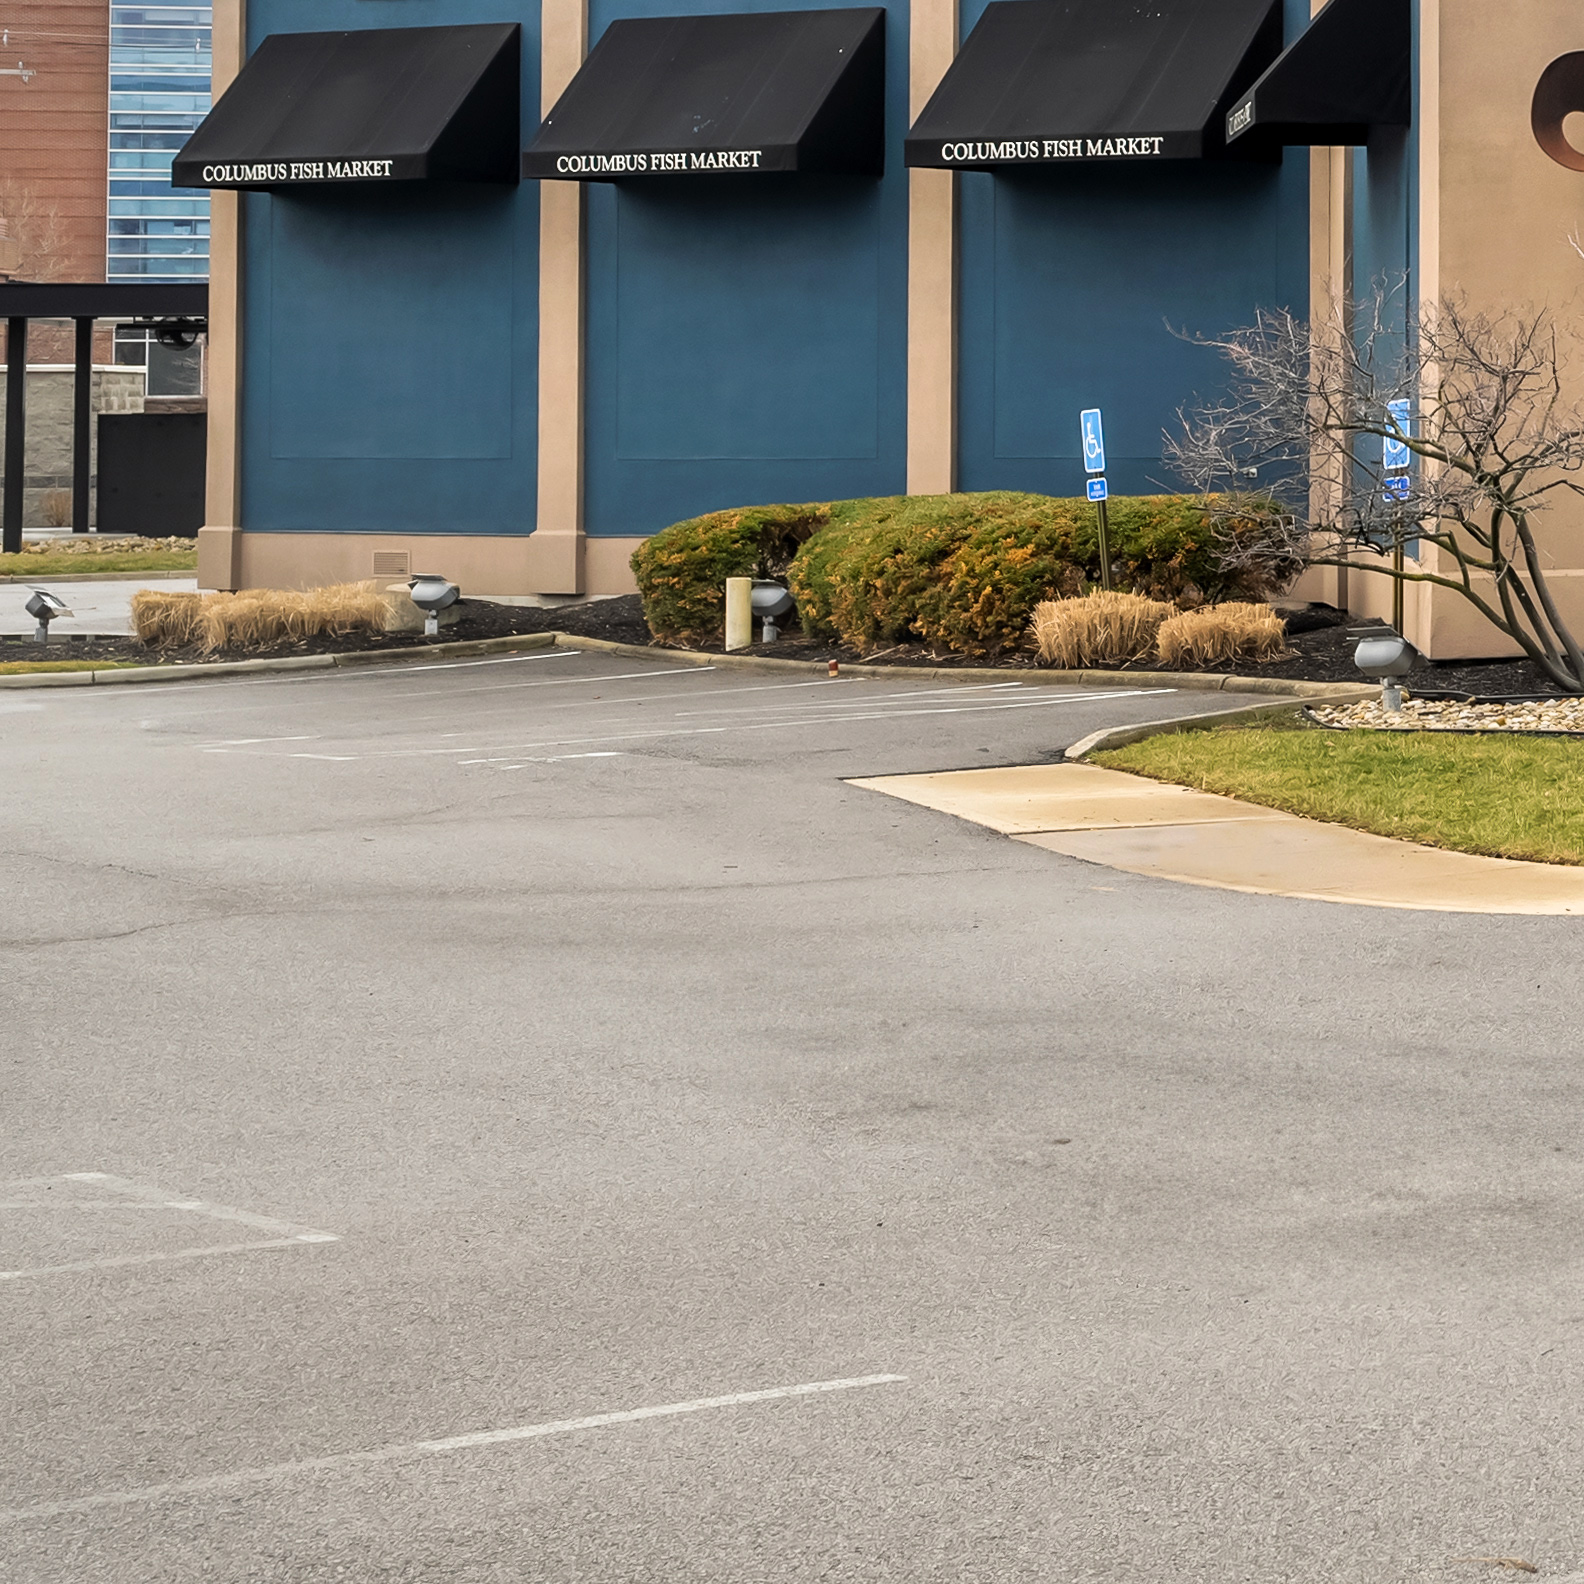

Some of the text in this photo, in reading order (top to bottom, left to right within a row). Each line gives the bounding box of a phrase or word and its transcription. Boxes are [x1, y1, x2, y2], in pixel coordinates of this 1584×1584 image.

[942, 137, 1163, 160] COLUMBUS FISH MARKET
[203, 160, 393, 181] COLUMBUS FISH MARKET
[557, 151, 761, 172] COLUMBUS FISH MARKET
